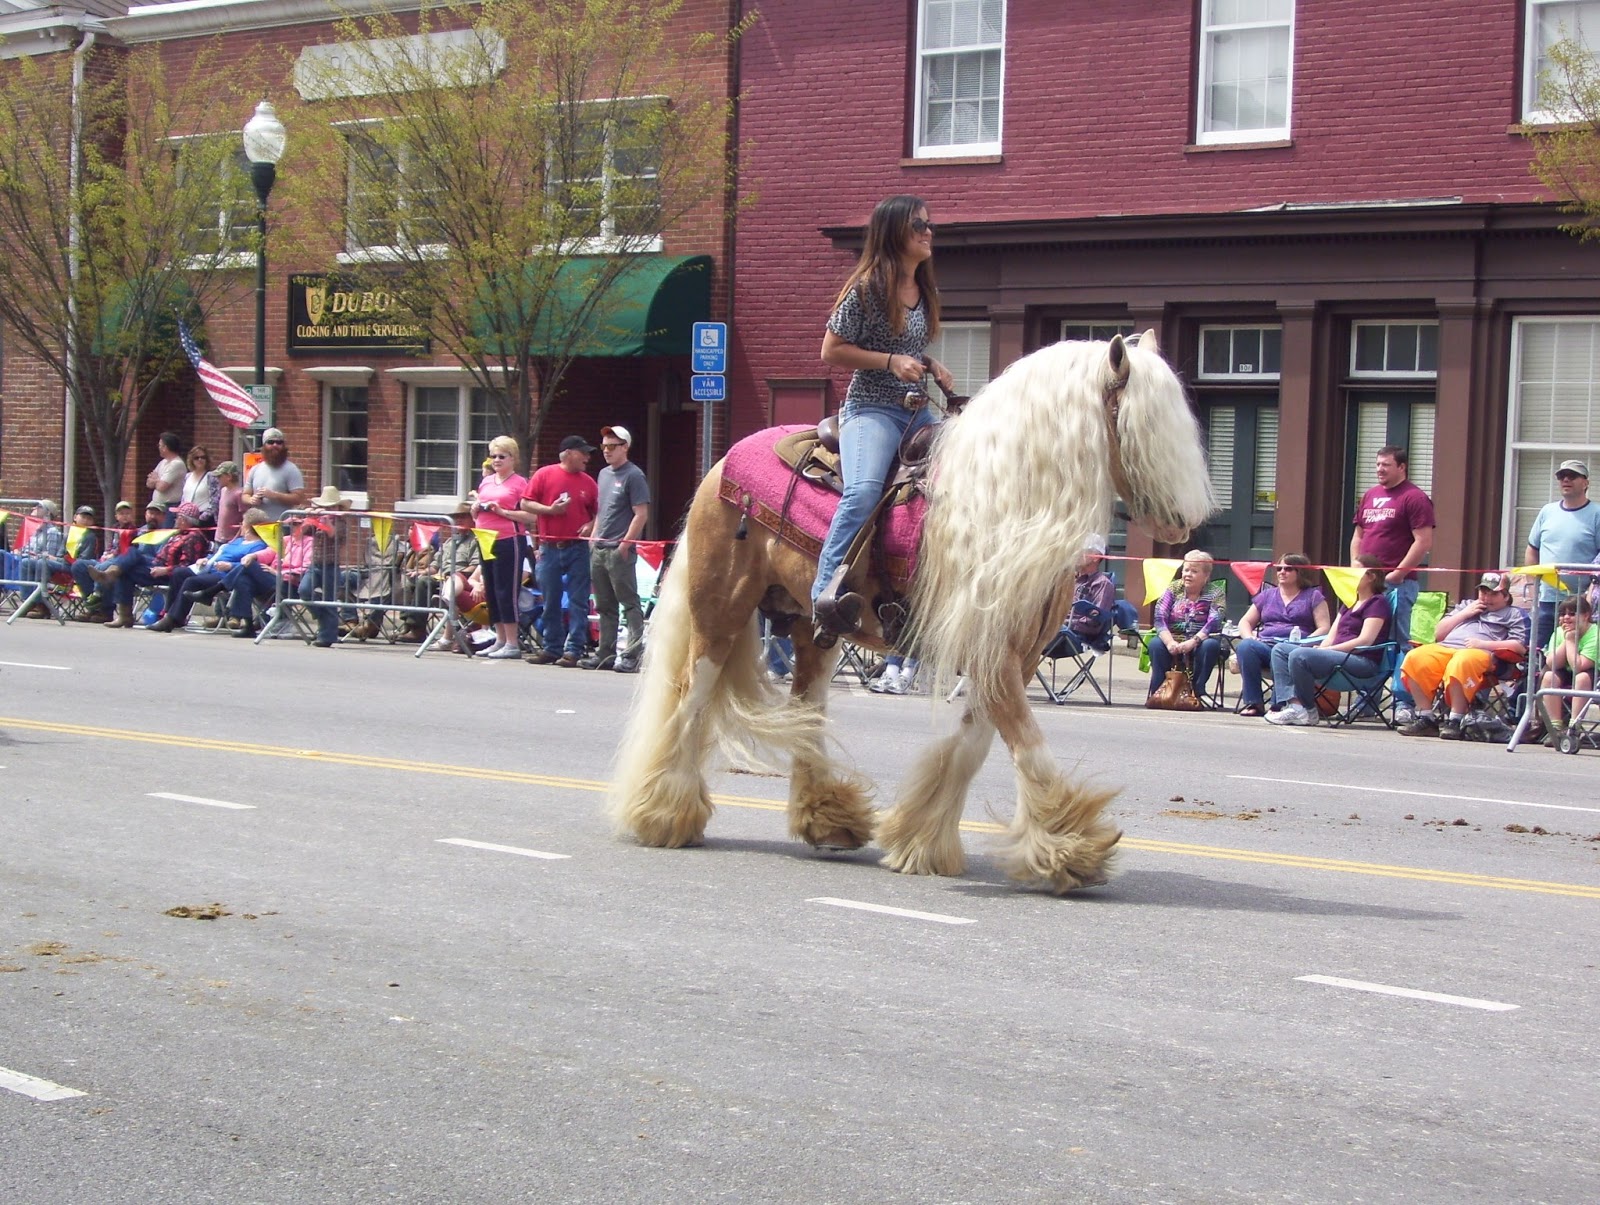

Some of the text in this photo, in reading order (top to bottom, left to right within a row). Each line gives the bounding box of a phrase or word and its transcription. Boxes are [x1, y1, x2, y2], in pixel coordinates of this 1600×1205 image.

[296, 324, 330, 337] CLOSING
[331, 325, 349, 337] AND
[694, 388, 723, 396] ACCESSIBLE
[1373, 497, 1392, 508] VT
